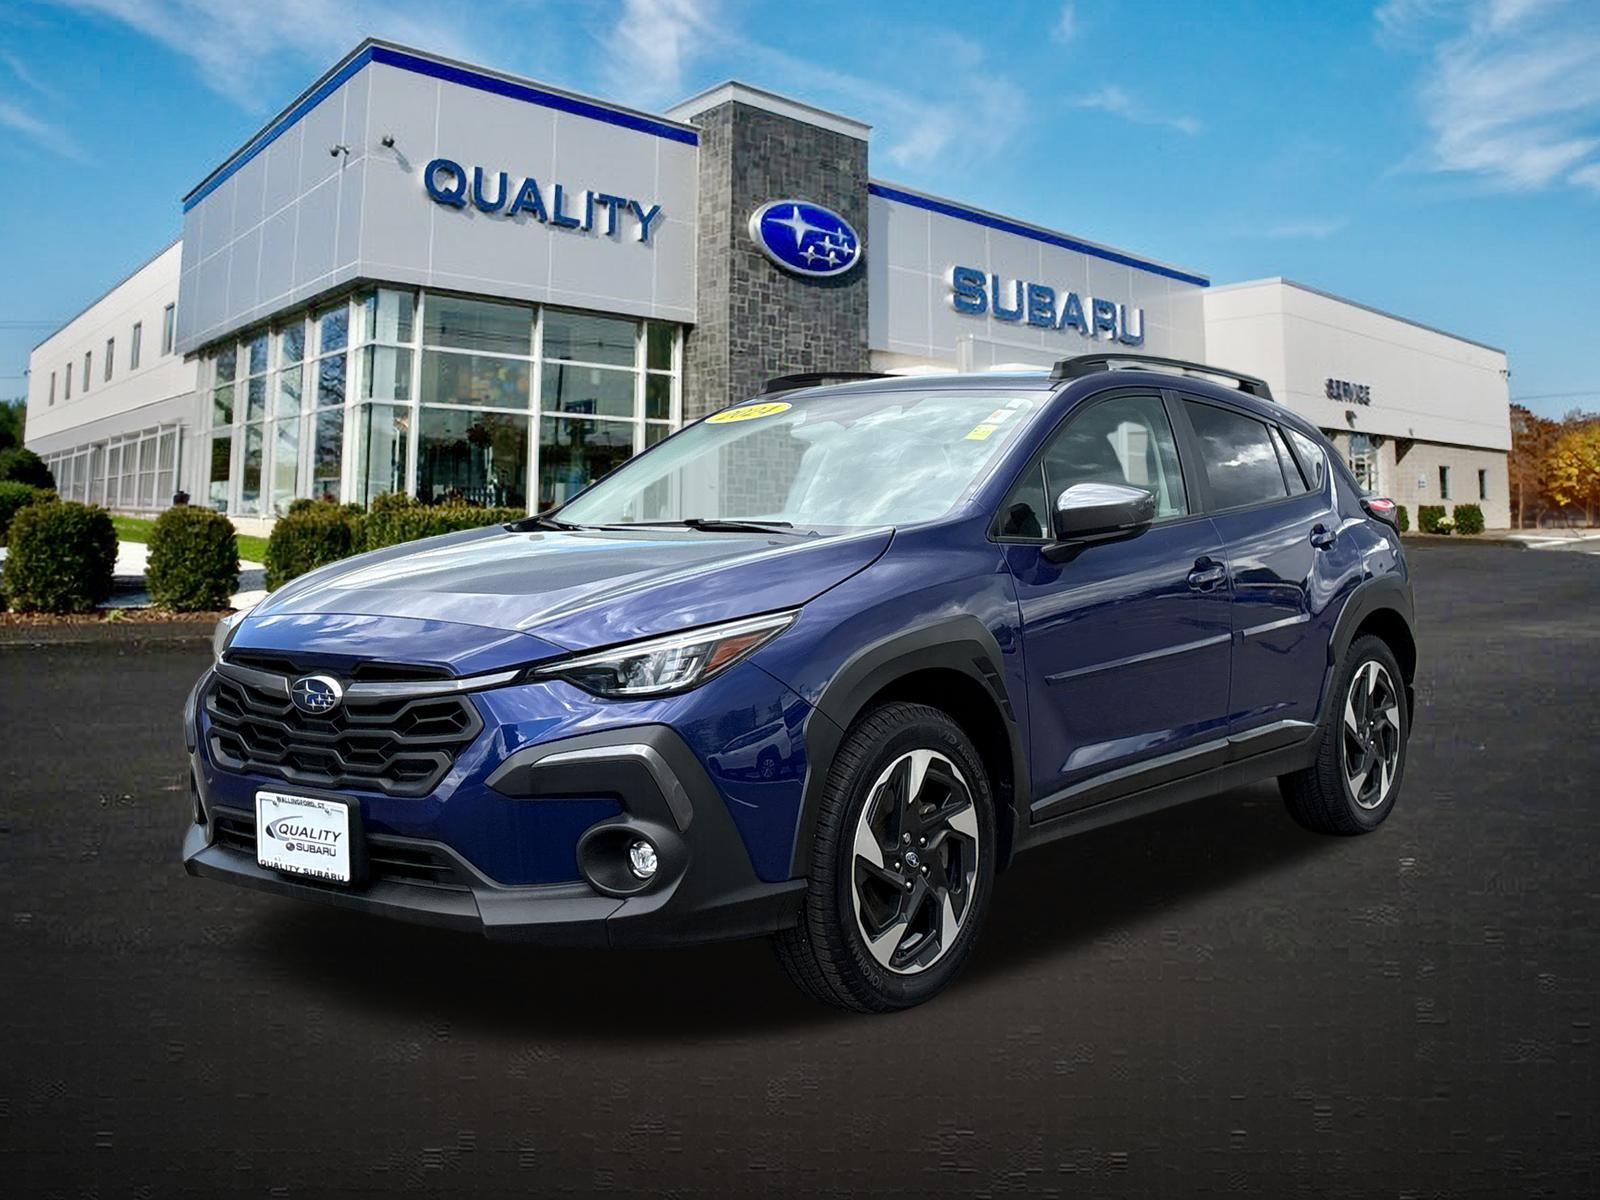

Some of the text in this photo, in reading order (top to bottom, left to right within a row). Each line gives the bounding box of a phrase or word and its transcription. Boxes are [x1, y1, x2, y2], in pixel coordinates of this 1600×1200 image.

[423, 157, 662, 243] QUALITY
[949, 265, 1145, 347] SUBARU
[1325, 377, 1371, 407] SERVICE
[278, 823, 342, 843] QUALITY
[295, 842, 337, 857] SUBARU
[260, 859, 345, 881] QUALITY SUBARU
